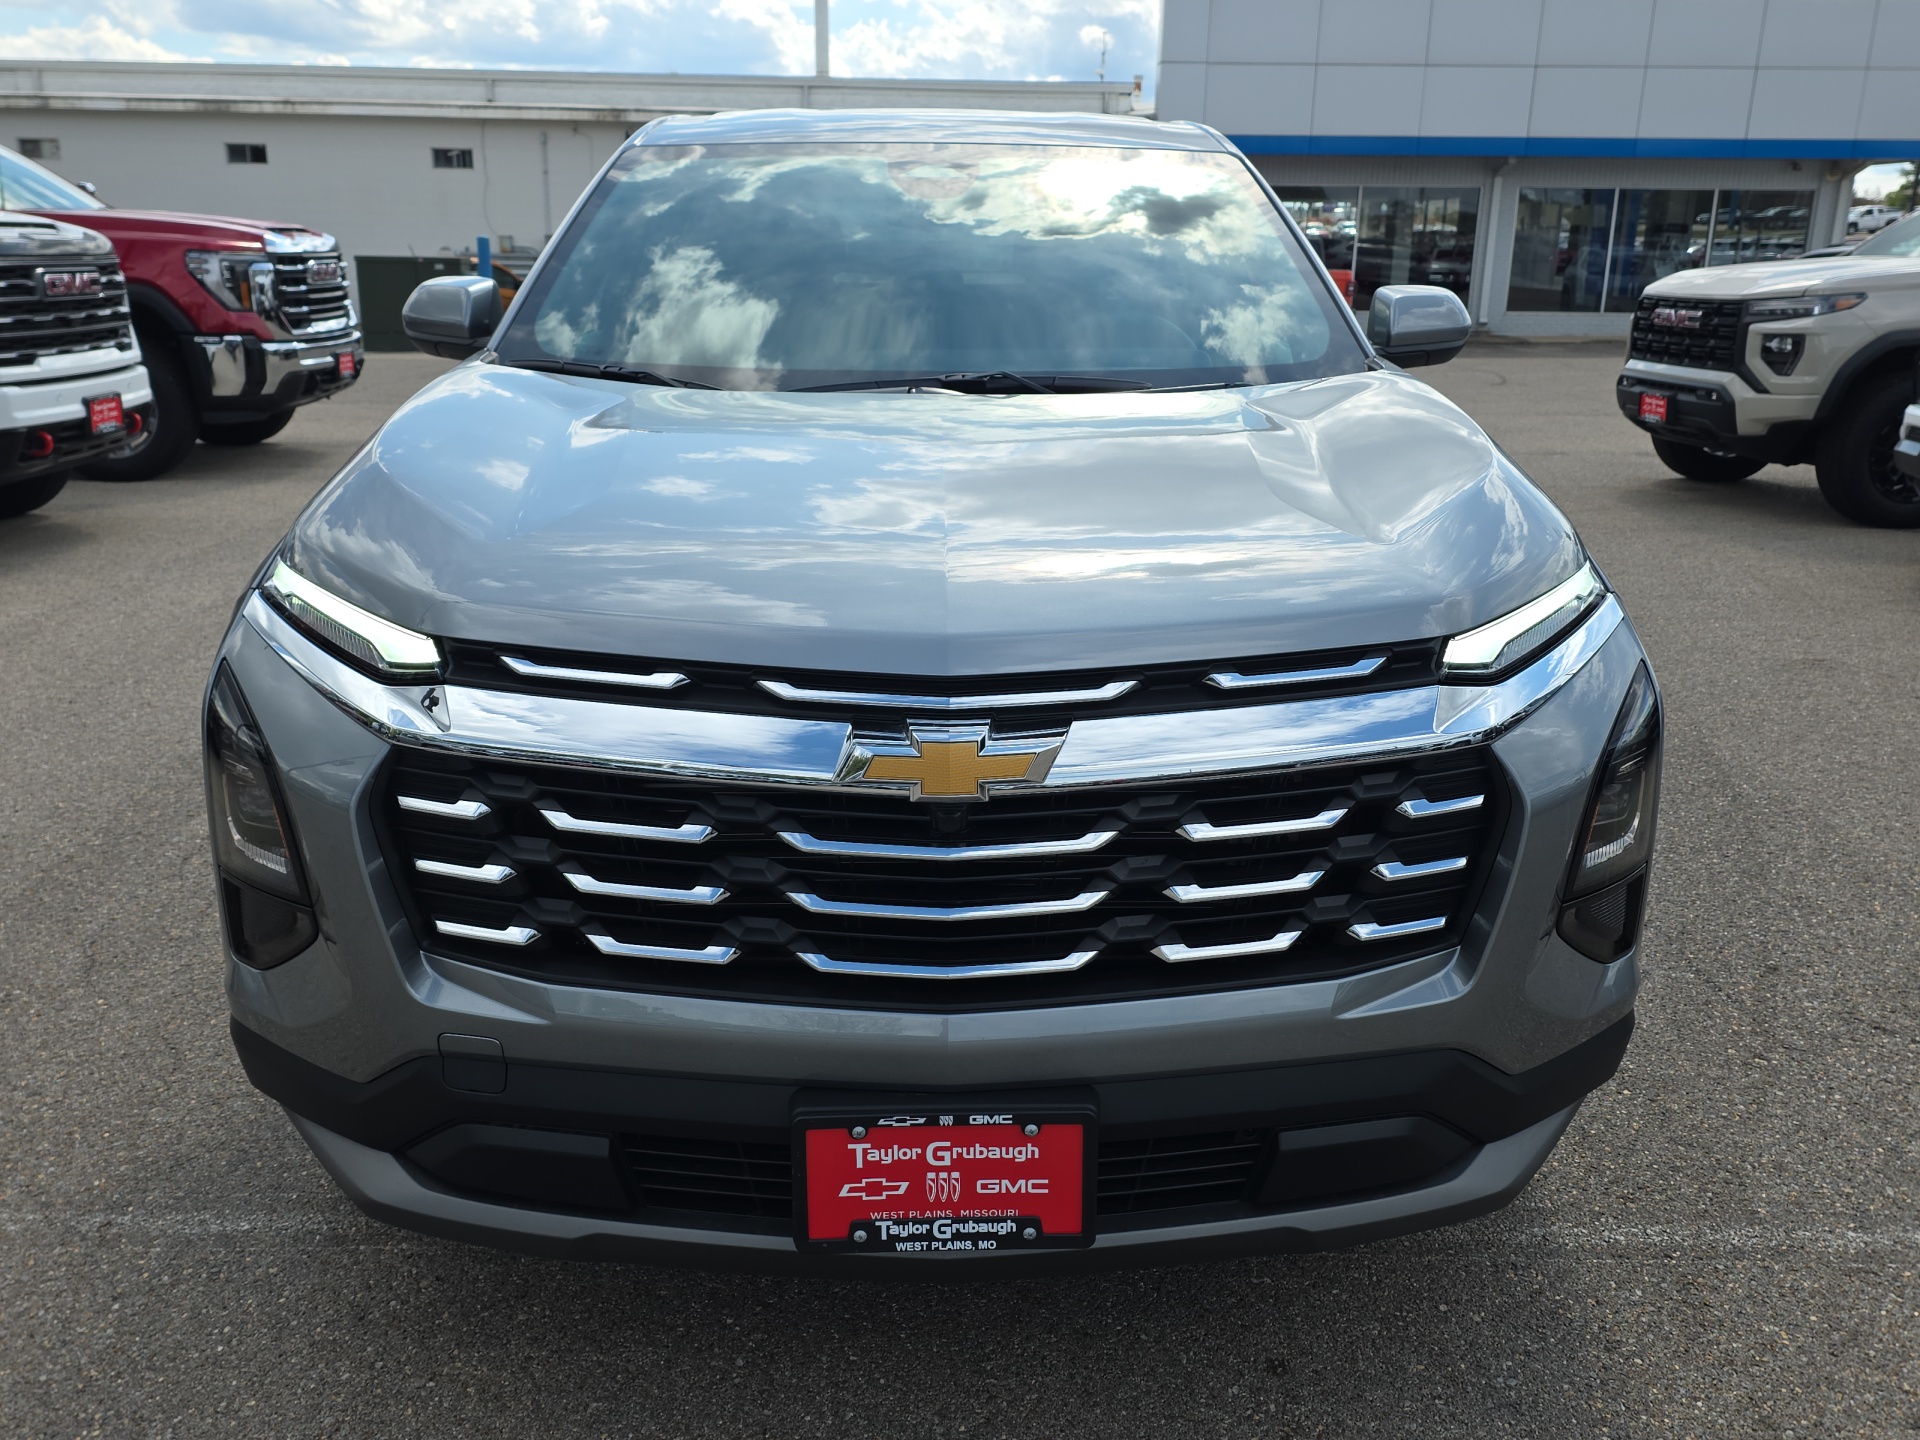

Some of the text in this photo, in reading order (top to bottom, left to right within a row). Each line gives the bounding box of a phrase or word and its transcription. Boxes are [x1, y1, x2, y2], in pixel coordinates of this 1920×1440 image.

[44, 272, 102, 296] GMC
[1650, 307, 1703, 328] GMC
[969, 1115, 1013, 1125] GMC
[847, 1141, 1039, 1169] Taylor Grubaugh
[976, 1179, 1049, 1194] GMC
[870, 1211, 905, 1220] WEST
[960, 1209, 1019, 1218] MISSOURI
[875, 1219, 1017, 1241] Taylor Grubaugh
[895, 1240, 997, 1252] WEST PLAINS, MO
